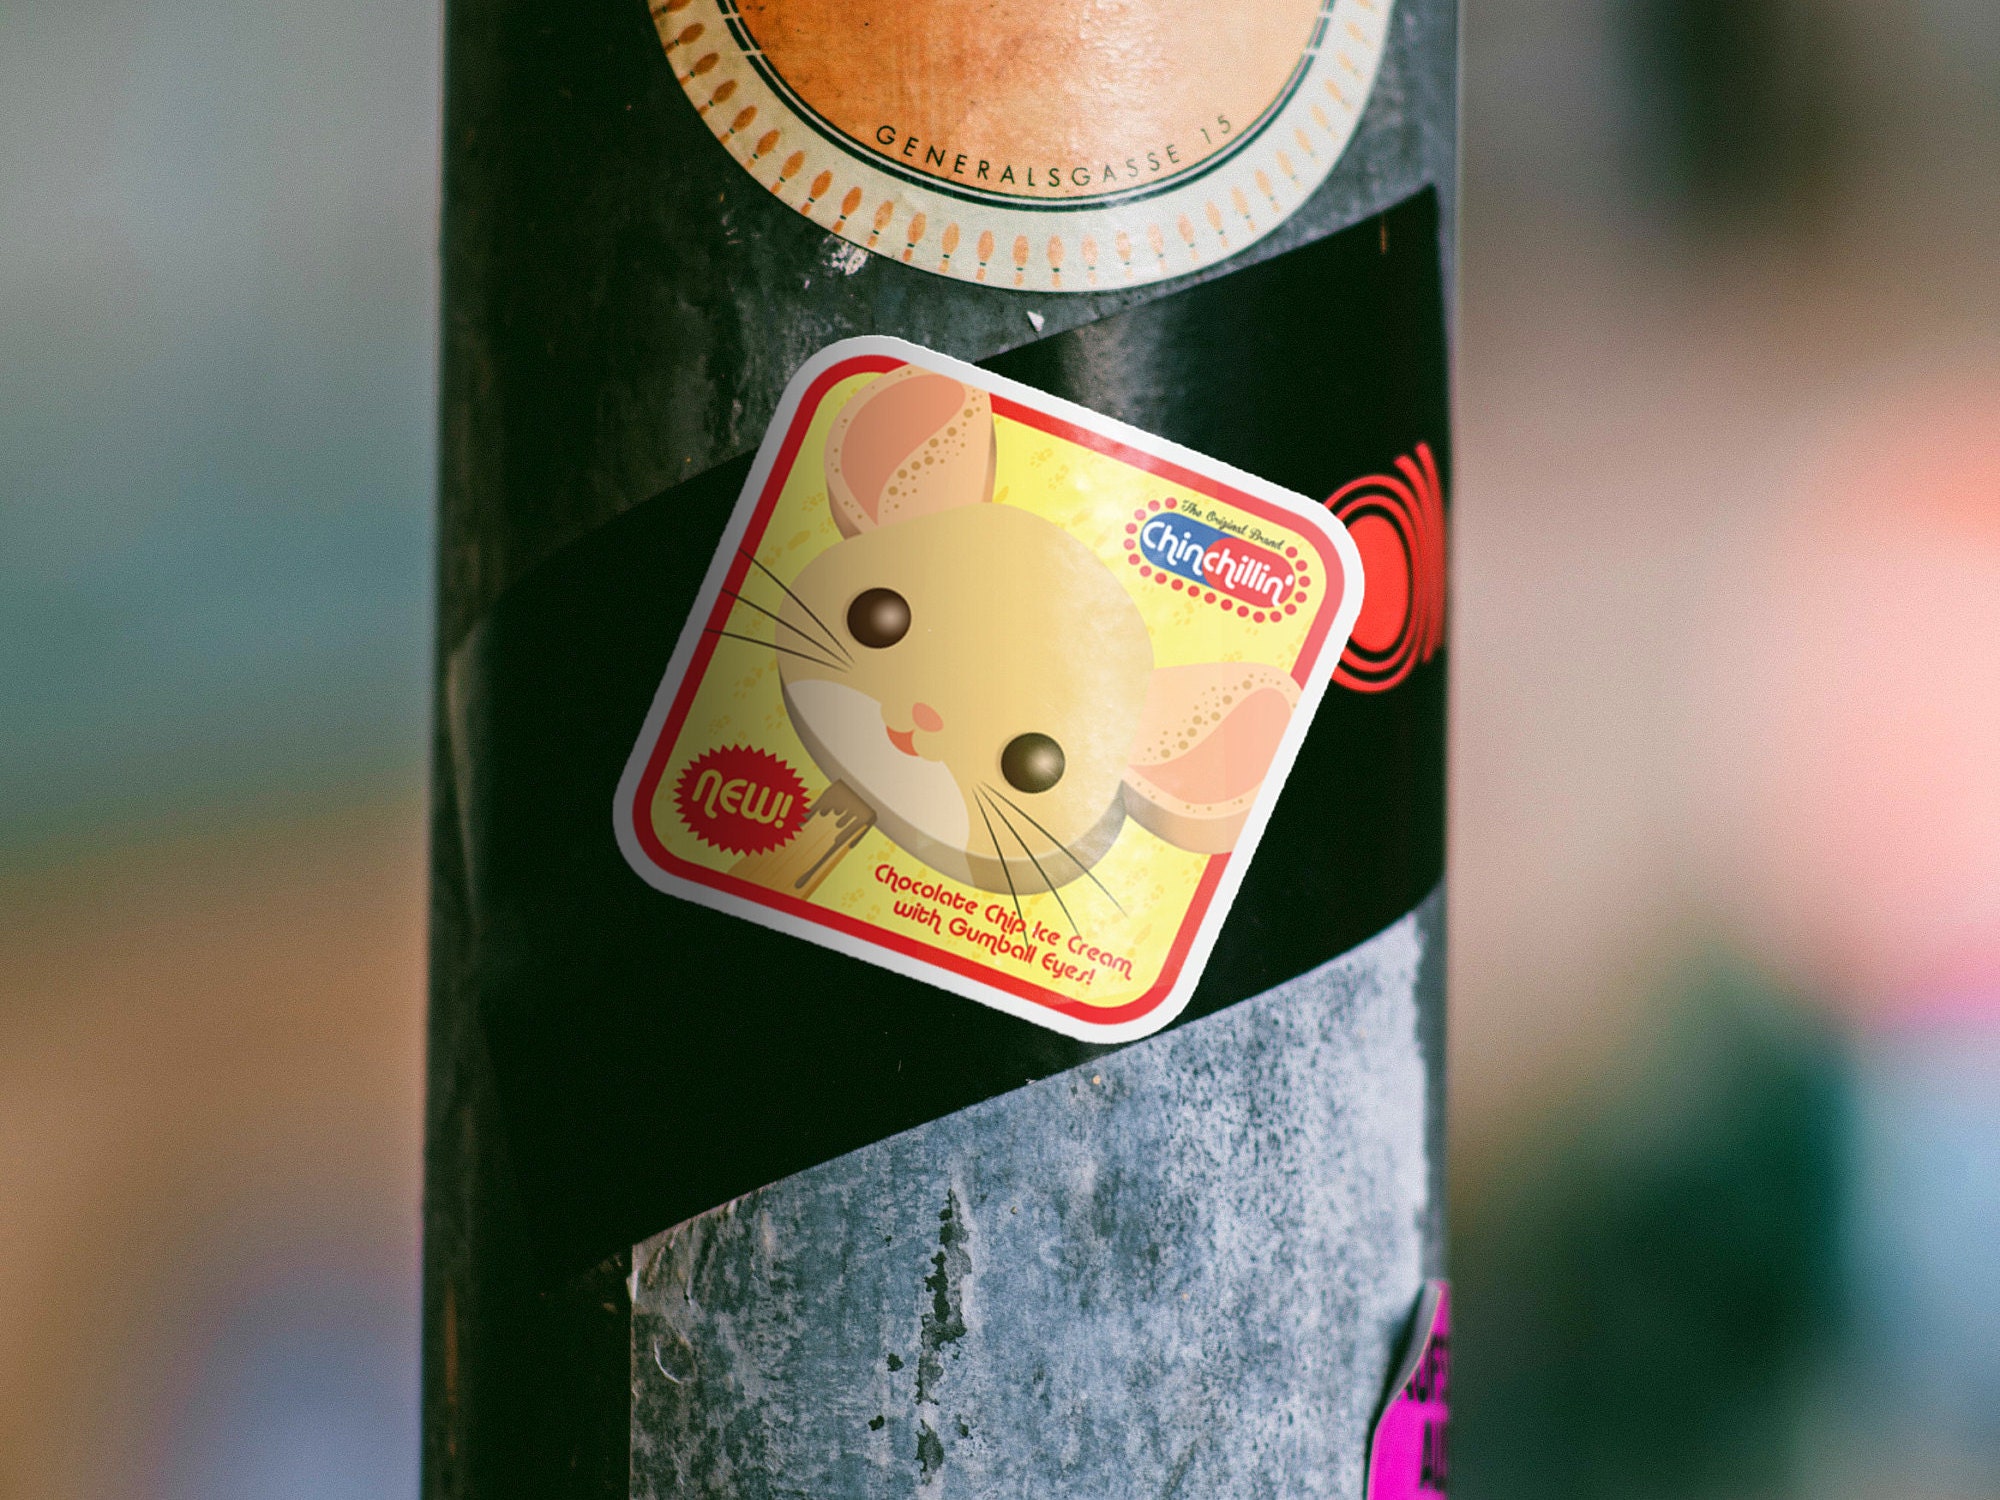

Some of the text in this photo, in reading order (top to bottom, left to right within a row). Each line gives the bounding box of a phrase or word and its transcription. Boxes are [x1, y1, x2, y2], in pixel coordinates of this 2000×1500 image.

[875, 115, 1232, 187] GENERALSGASSE 15
[1181, 499, 1286, 550] The Original Brand
[875, 864, 1133, 981] Chocolate Chip Ice Cream
[893, 900, 1096, 986] with Gumball Eyes!
